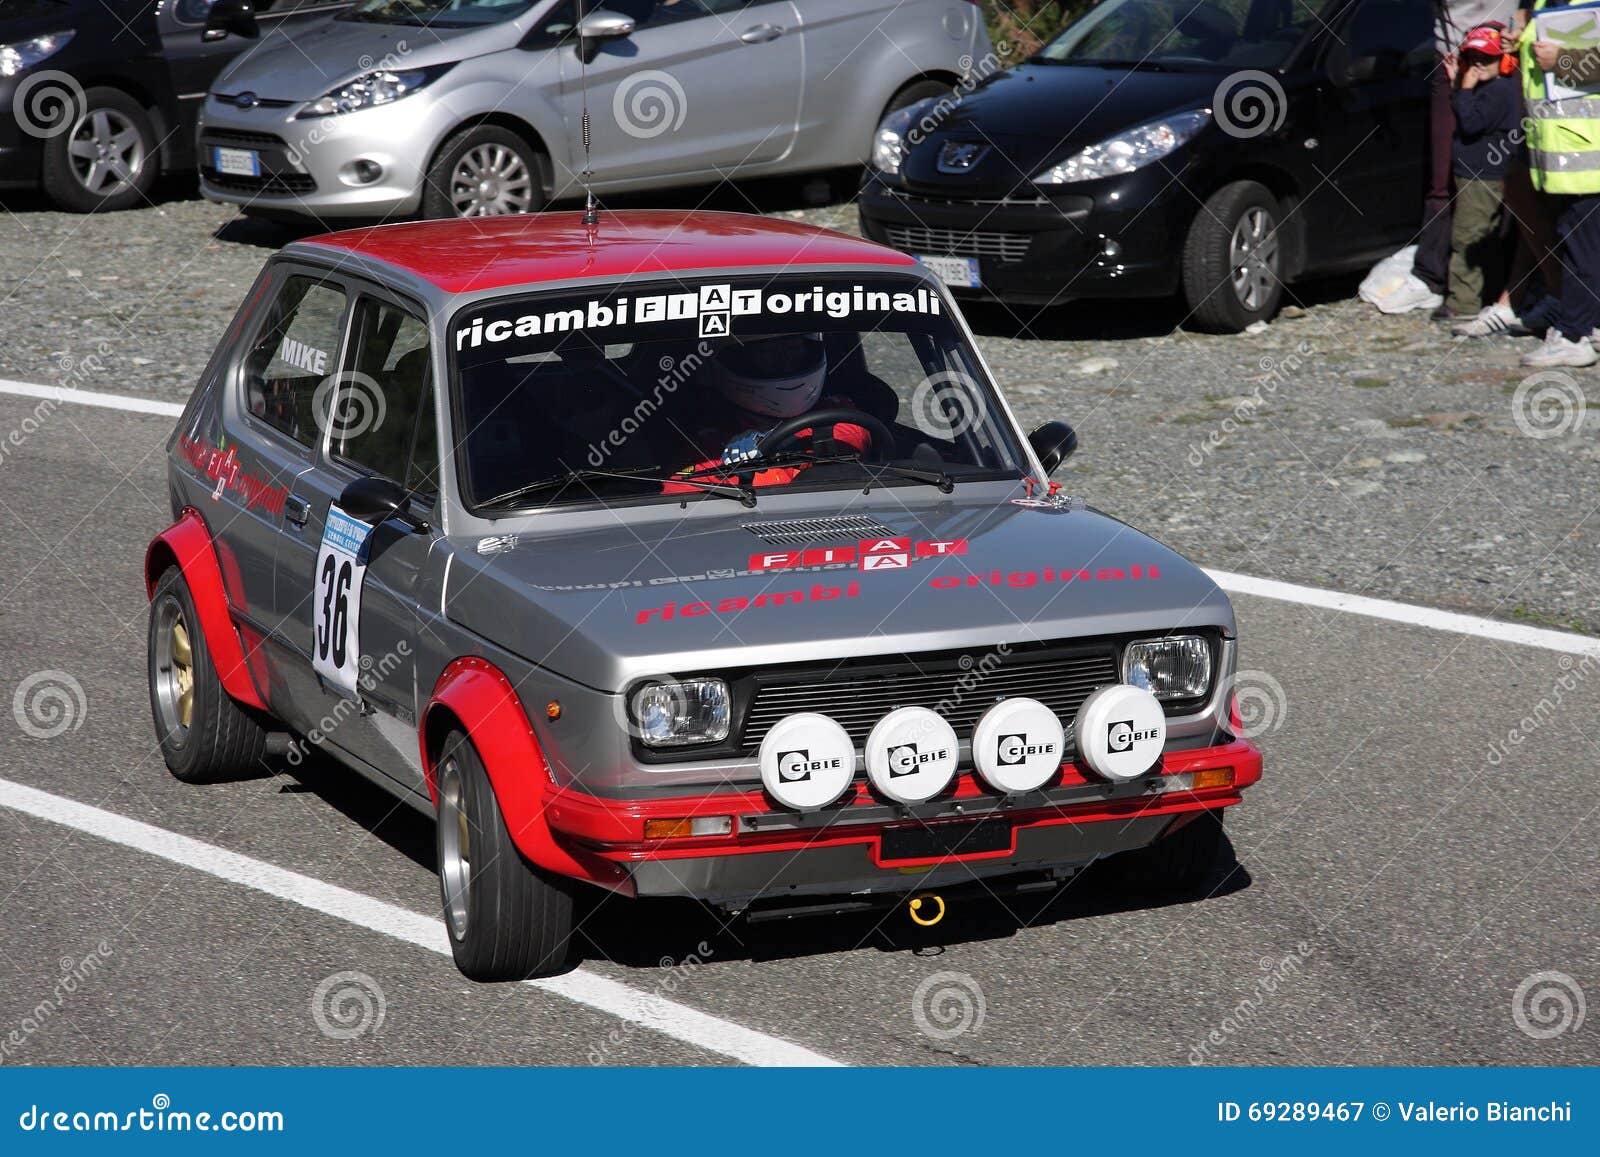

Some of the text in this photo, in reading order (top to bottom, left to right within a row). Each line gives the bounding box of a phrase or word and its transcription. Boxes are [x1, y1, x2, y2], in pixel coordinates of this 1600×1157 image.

[456, 287, 756, 351] ricambi FIAT
[767, 285, 940, 317] originali
[281, 336, 327, 376] MIKE
[761, 539, 956, 568] FIAT
[317, 553, 352, 669] 36
[635, 564, 1161, 625] ricambi originali
